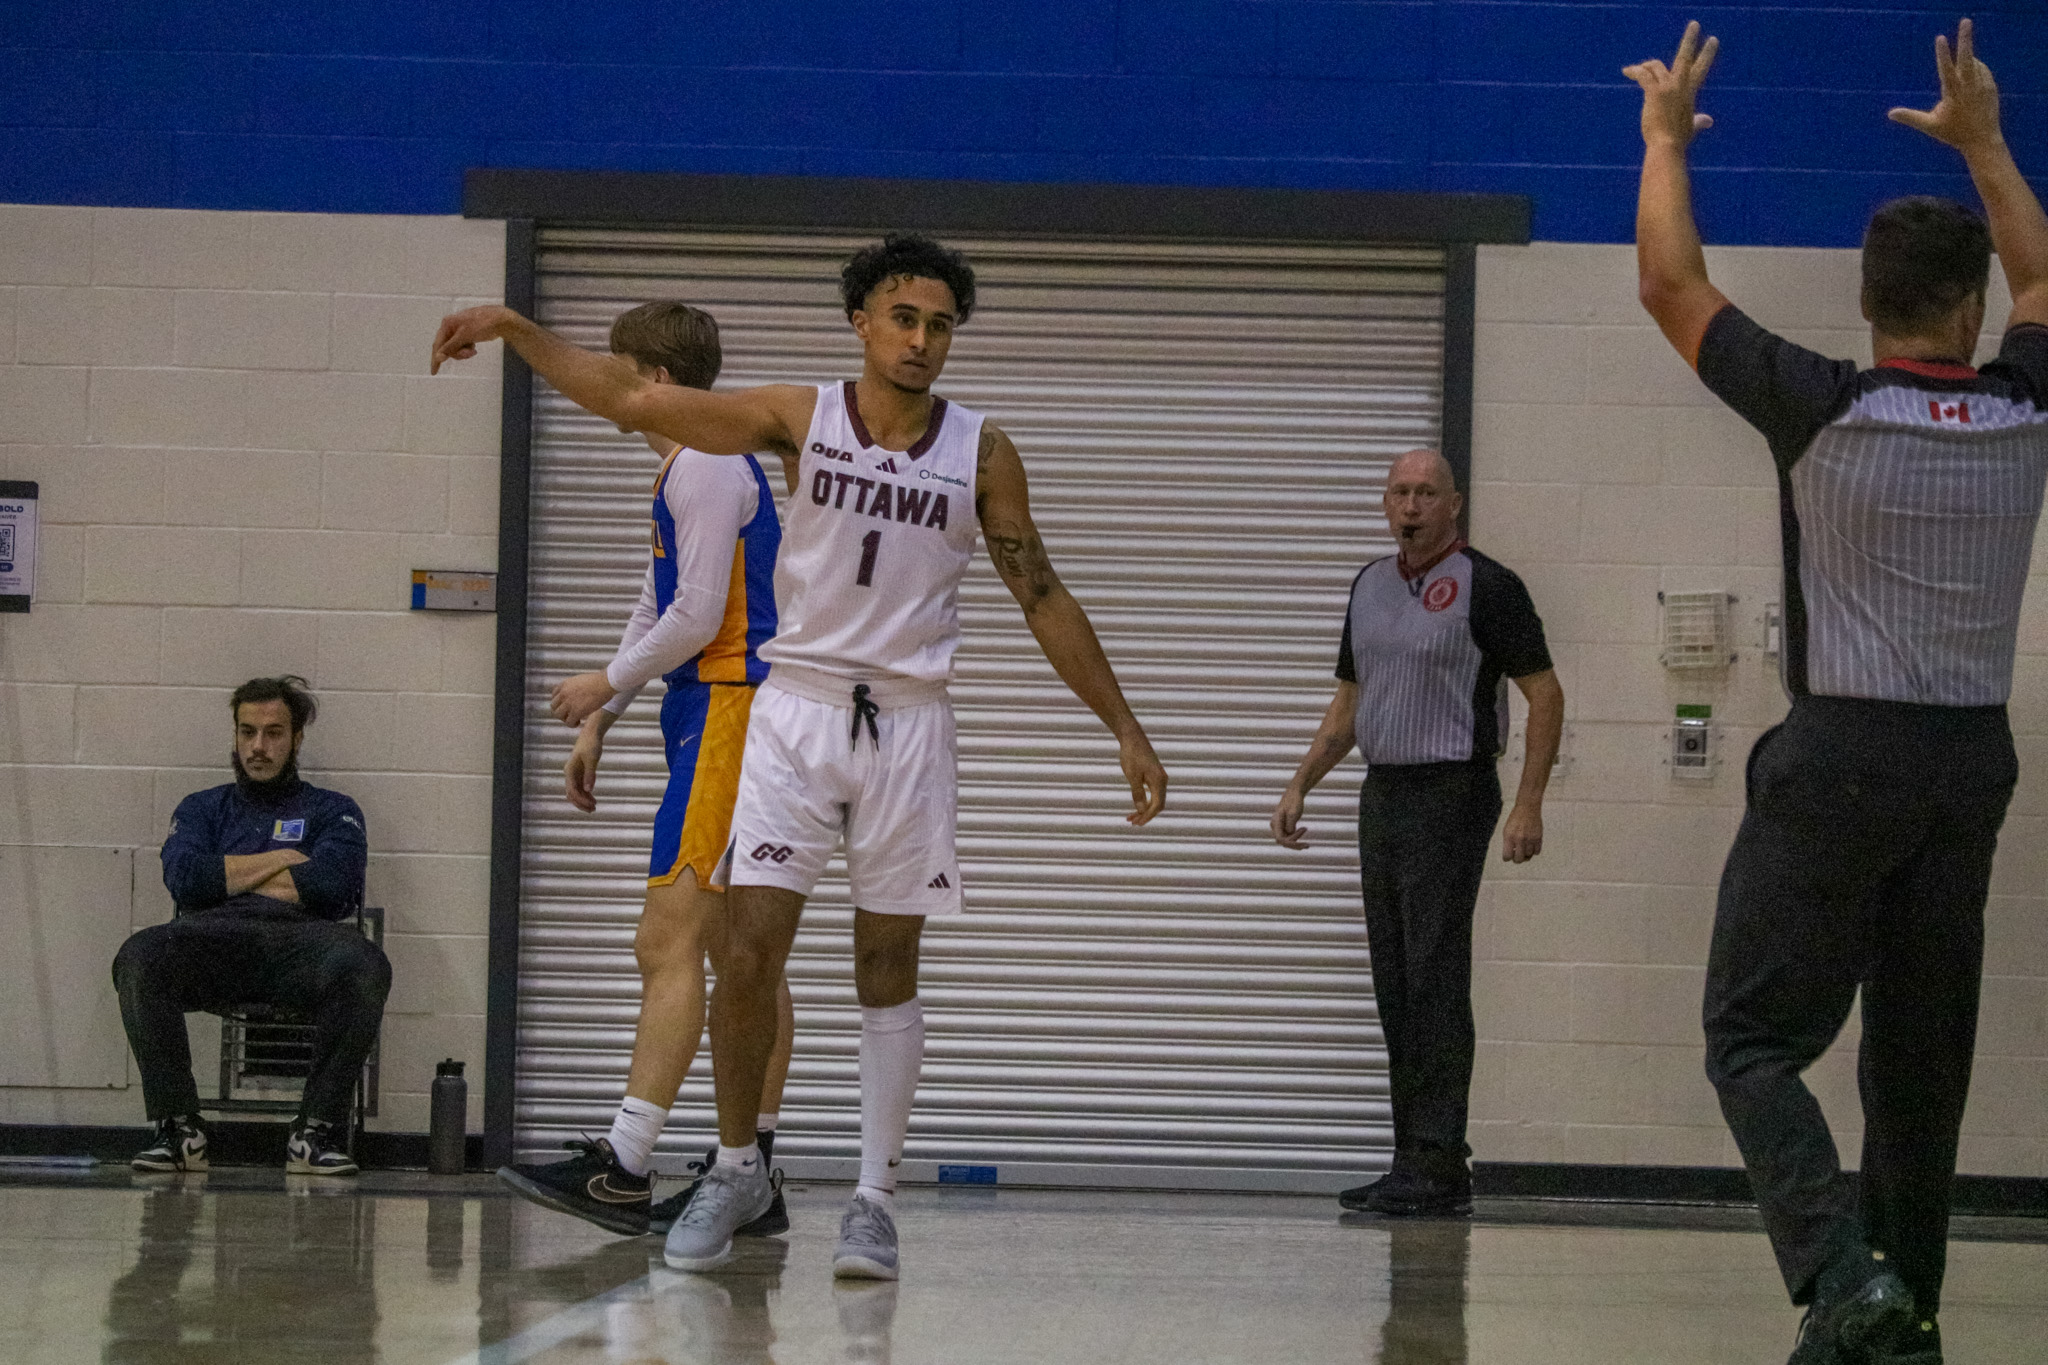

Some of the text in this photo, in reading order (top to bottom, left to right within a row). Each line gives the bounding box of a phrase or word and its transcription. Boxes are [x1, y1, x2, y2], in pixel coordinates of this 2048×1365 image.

[811, 442, 854, 463] OUA
[812, 469, 949, 531] OTTAWA
[932, 473, 967, 488] Desjardins
[856, 530, 882, 587] 1
